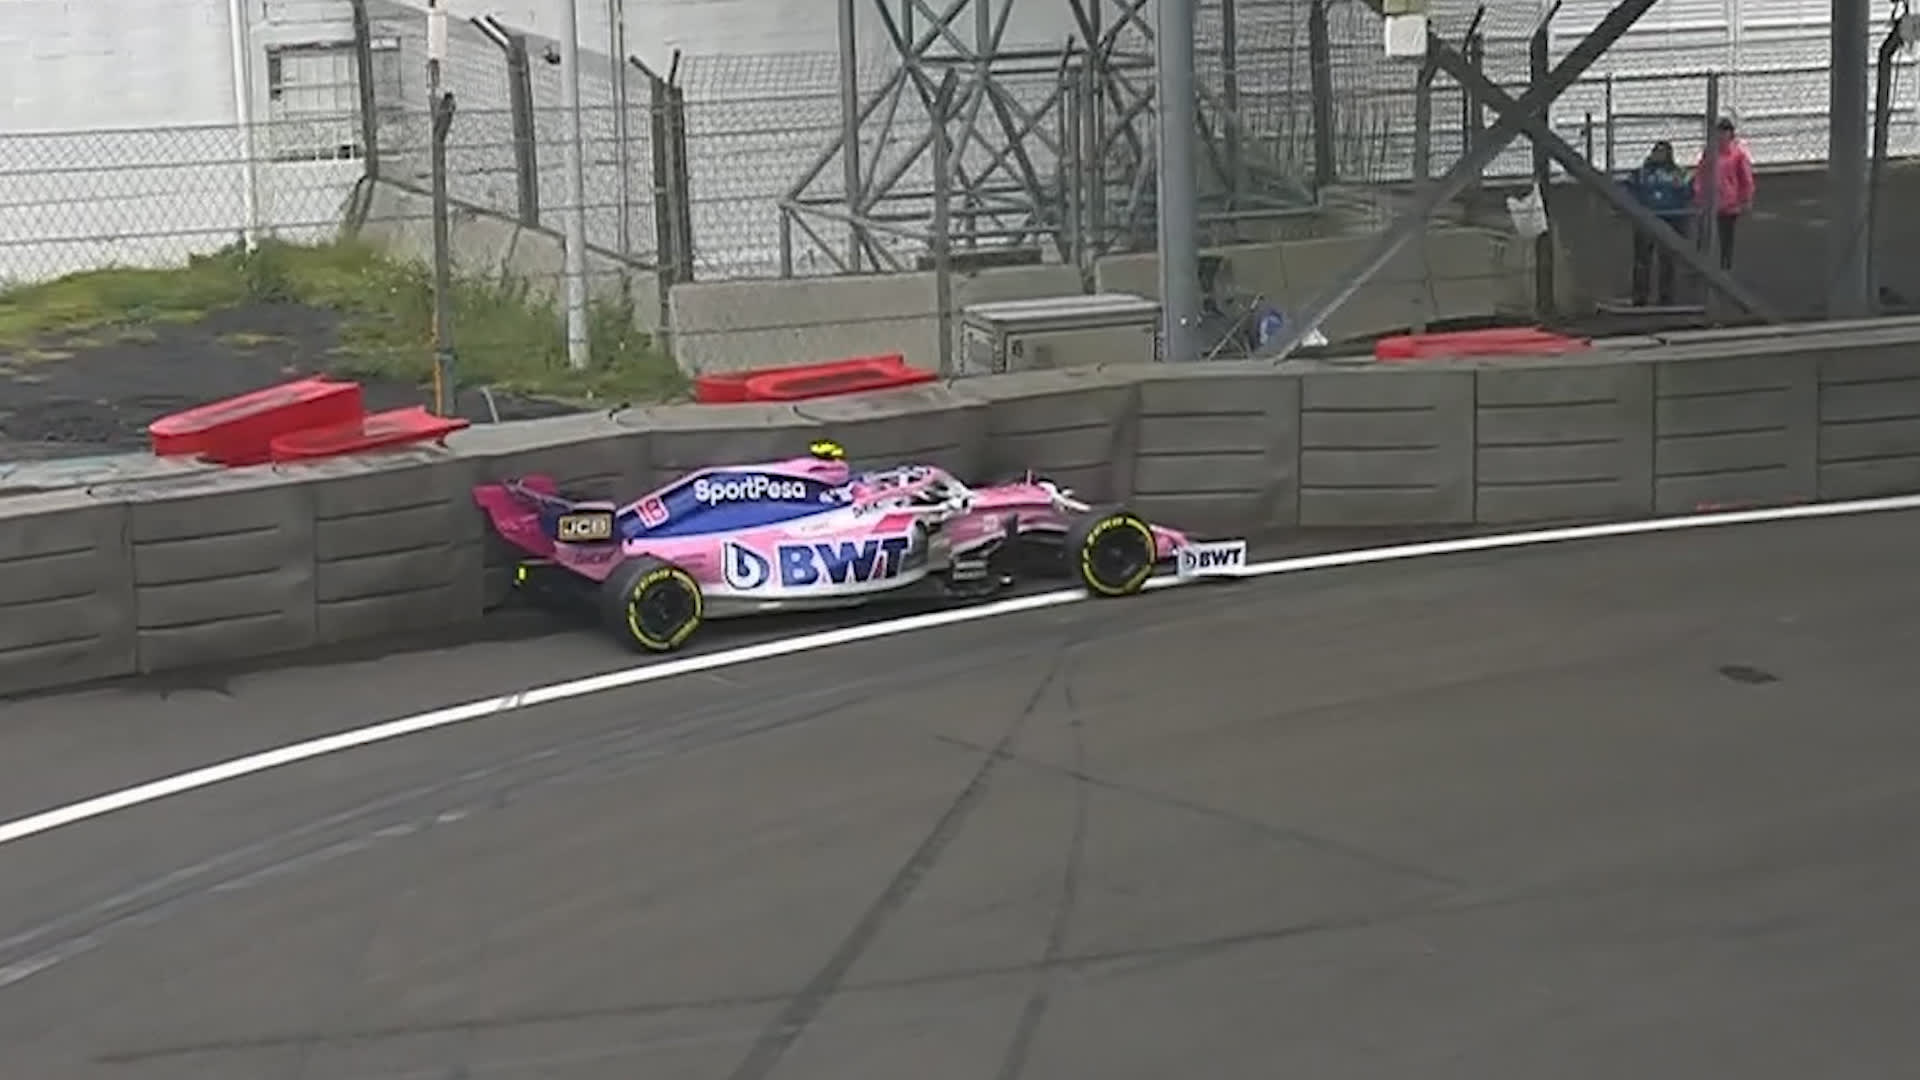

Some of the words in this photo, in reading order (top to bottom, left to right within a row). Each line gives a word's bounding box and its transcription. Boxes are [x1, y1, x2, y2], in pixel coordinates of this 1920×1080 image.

[693, 475, 806, 506] SportPesa
[562, 516, 607, 535] JCB
[779, 537, 909, 587] BWT
[1199, 547, 1242, 568] BWT
